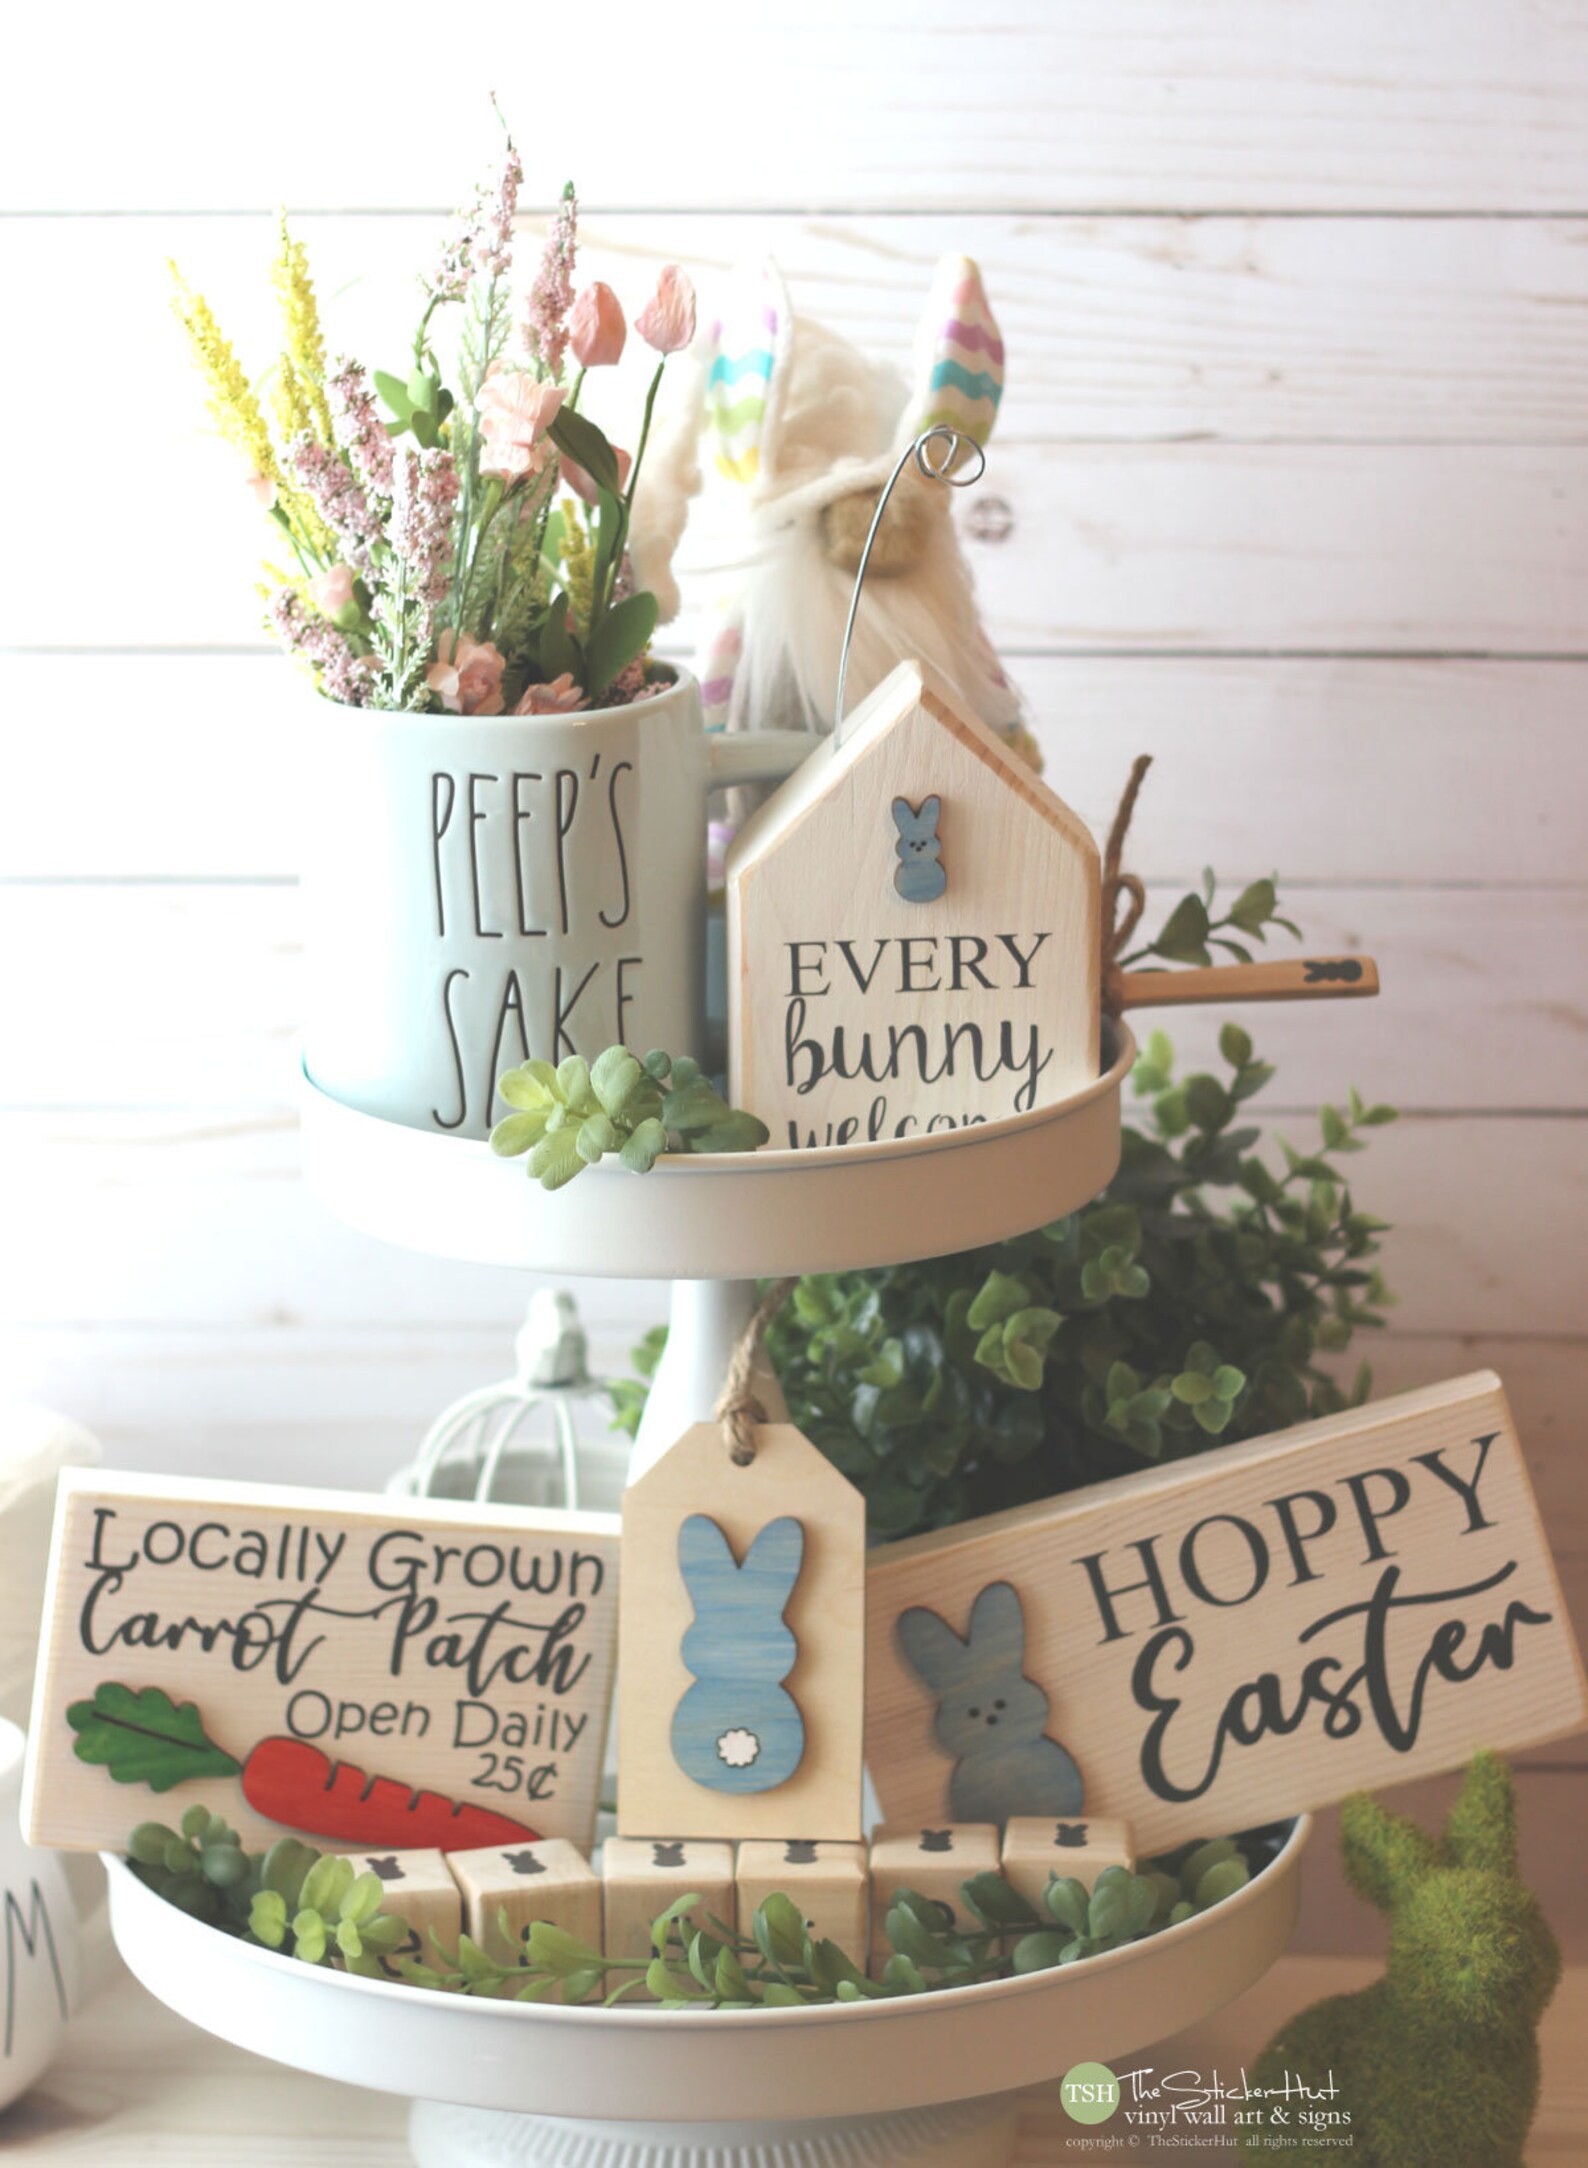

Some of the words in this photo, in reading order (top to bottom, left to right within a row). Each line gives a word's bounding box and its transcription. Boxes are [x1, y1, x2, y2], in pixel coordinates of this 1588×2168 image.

[432, 753, 633, 937] PEEP'S
[783, 932, 1053, 998] EVERY
[785, 997, 1054, 1114] bunny
[84, 1508, 346, 1583] Locally
[367, 1529, 605, 1597] Grown
[1071, 1431, 1502, 1645] HOPPY
[79, 1568, 360, 1685] Carrot
[382, 1592, 593, 1698] Patch
[1130, 1559, 1553, 1803] Easter
[286, 1690, 431, 1739] Open
[452, 1699, 588, 1752] Daily
[470, 1752, 559, 1800] 25¢
